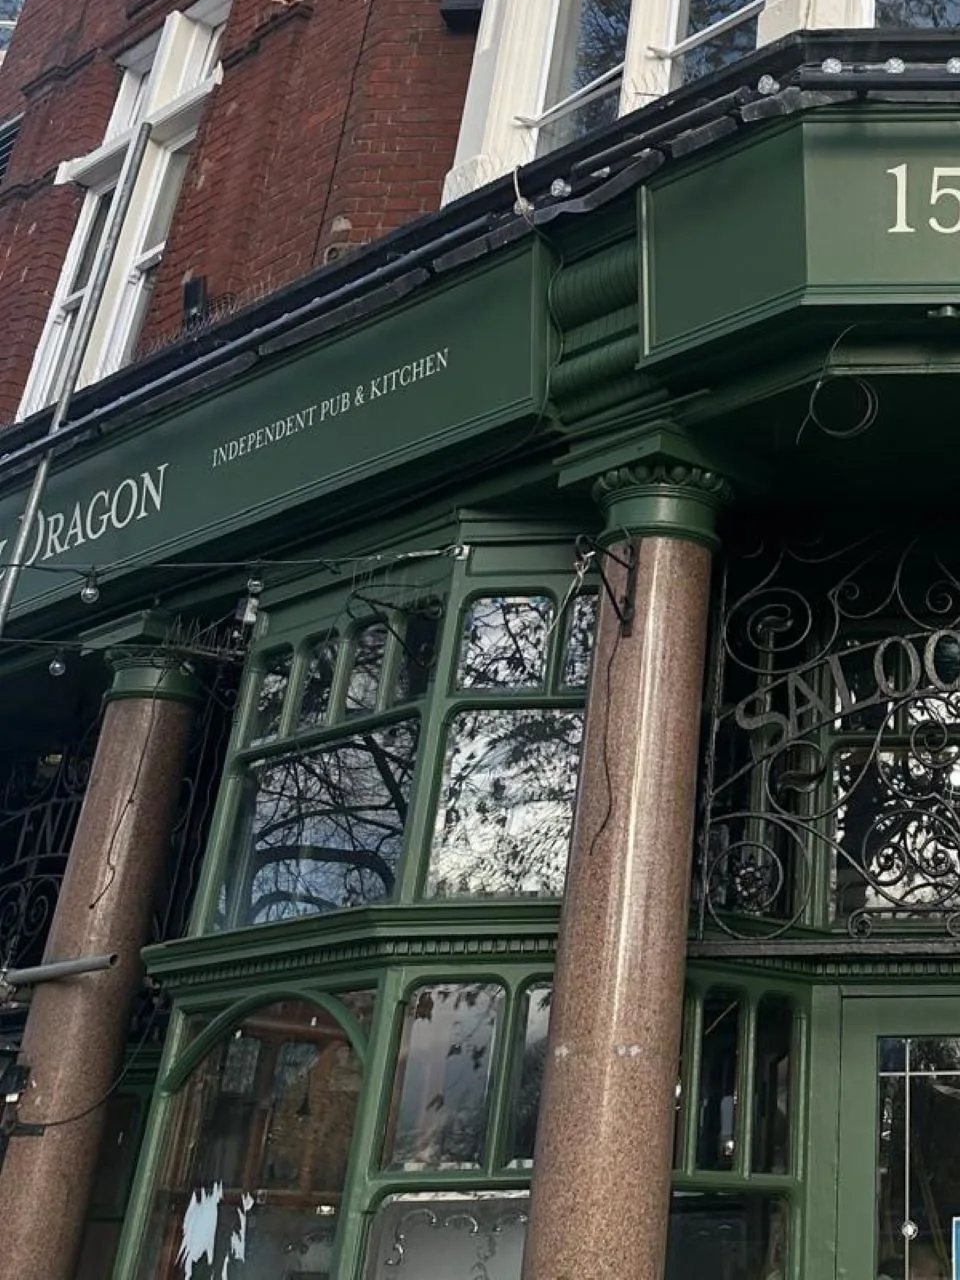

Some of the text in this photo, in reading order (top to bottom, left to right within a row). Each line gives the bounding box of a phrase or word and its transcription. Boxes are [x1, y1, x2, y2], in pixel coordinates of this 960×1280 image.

[212, 348, 449, 468] INDEPENDENT PUB & KITCHEN
